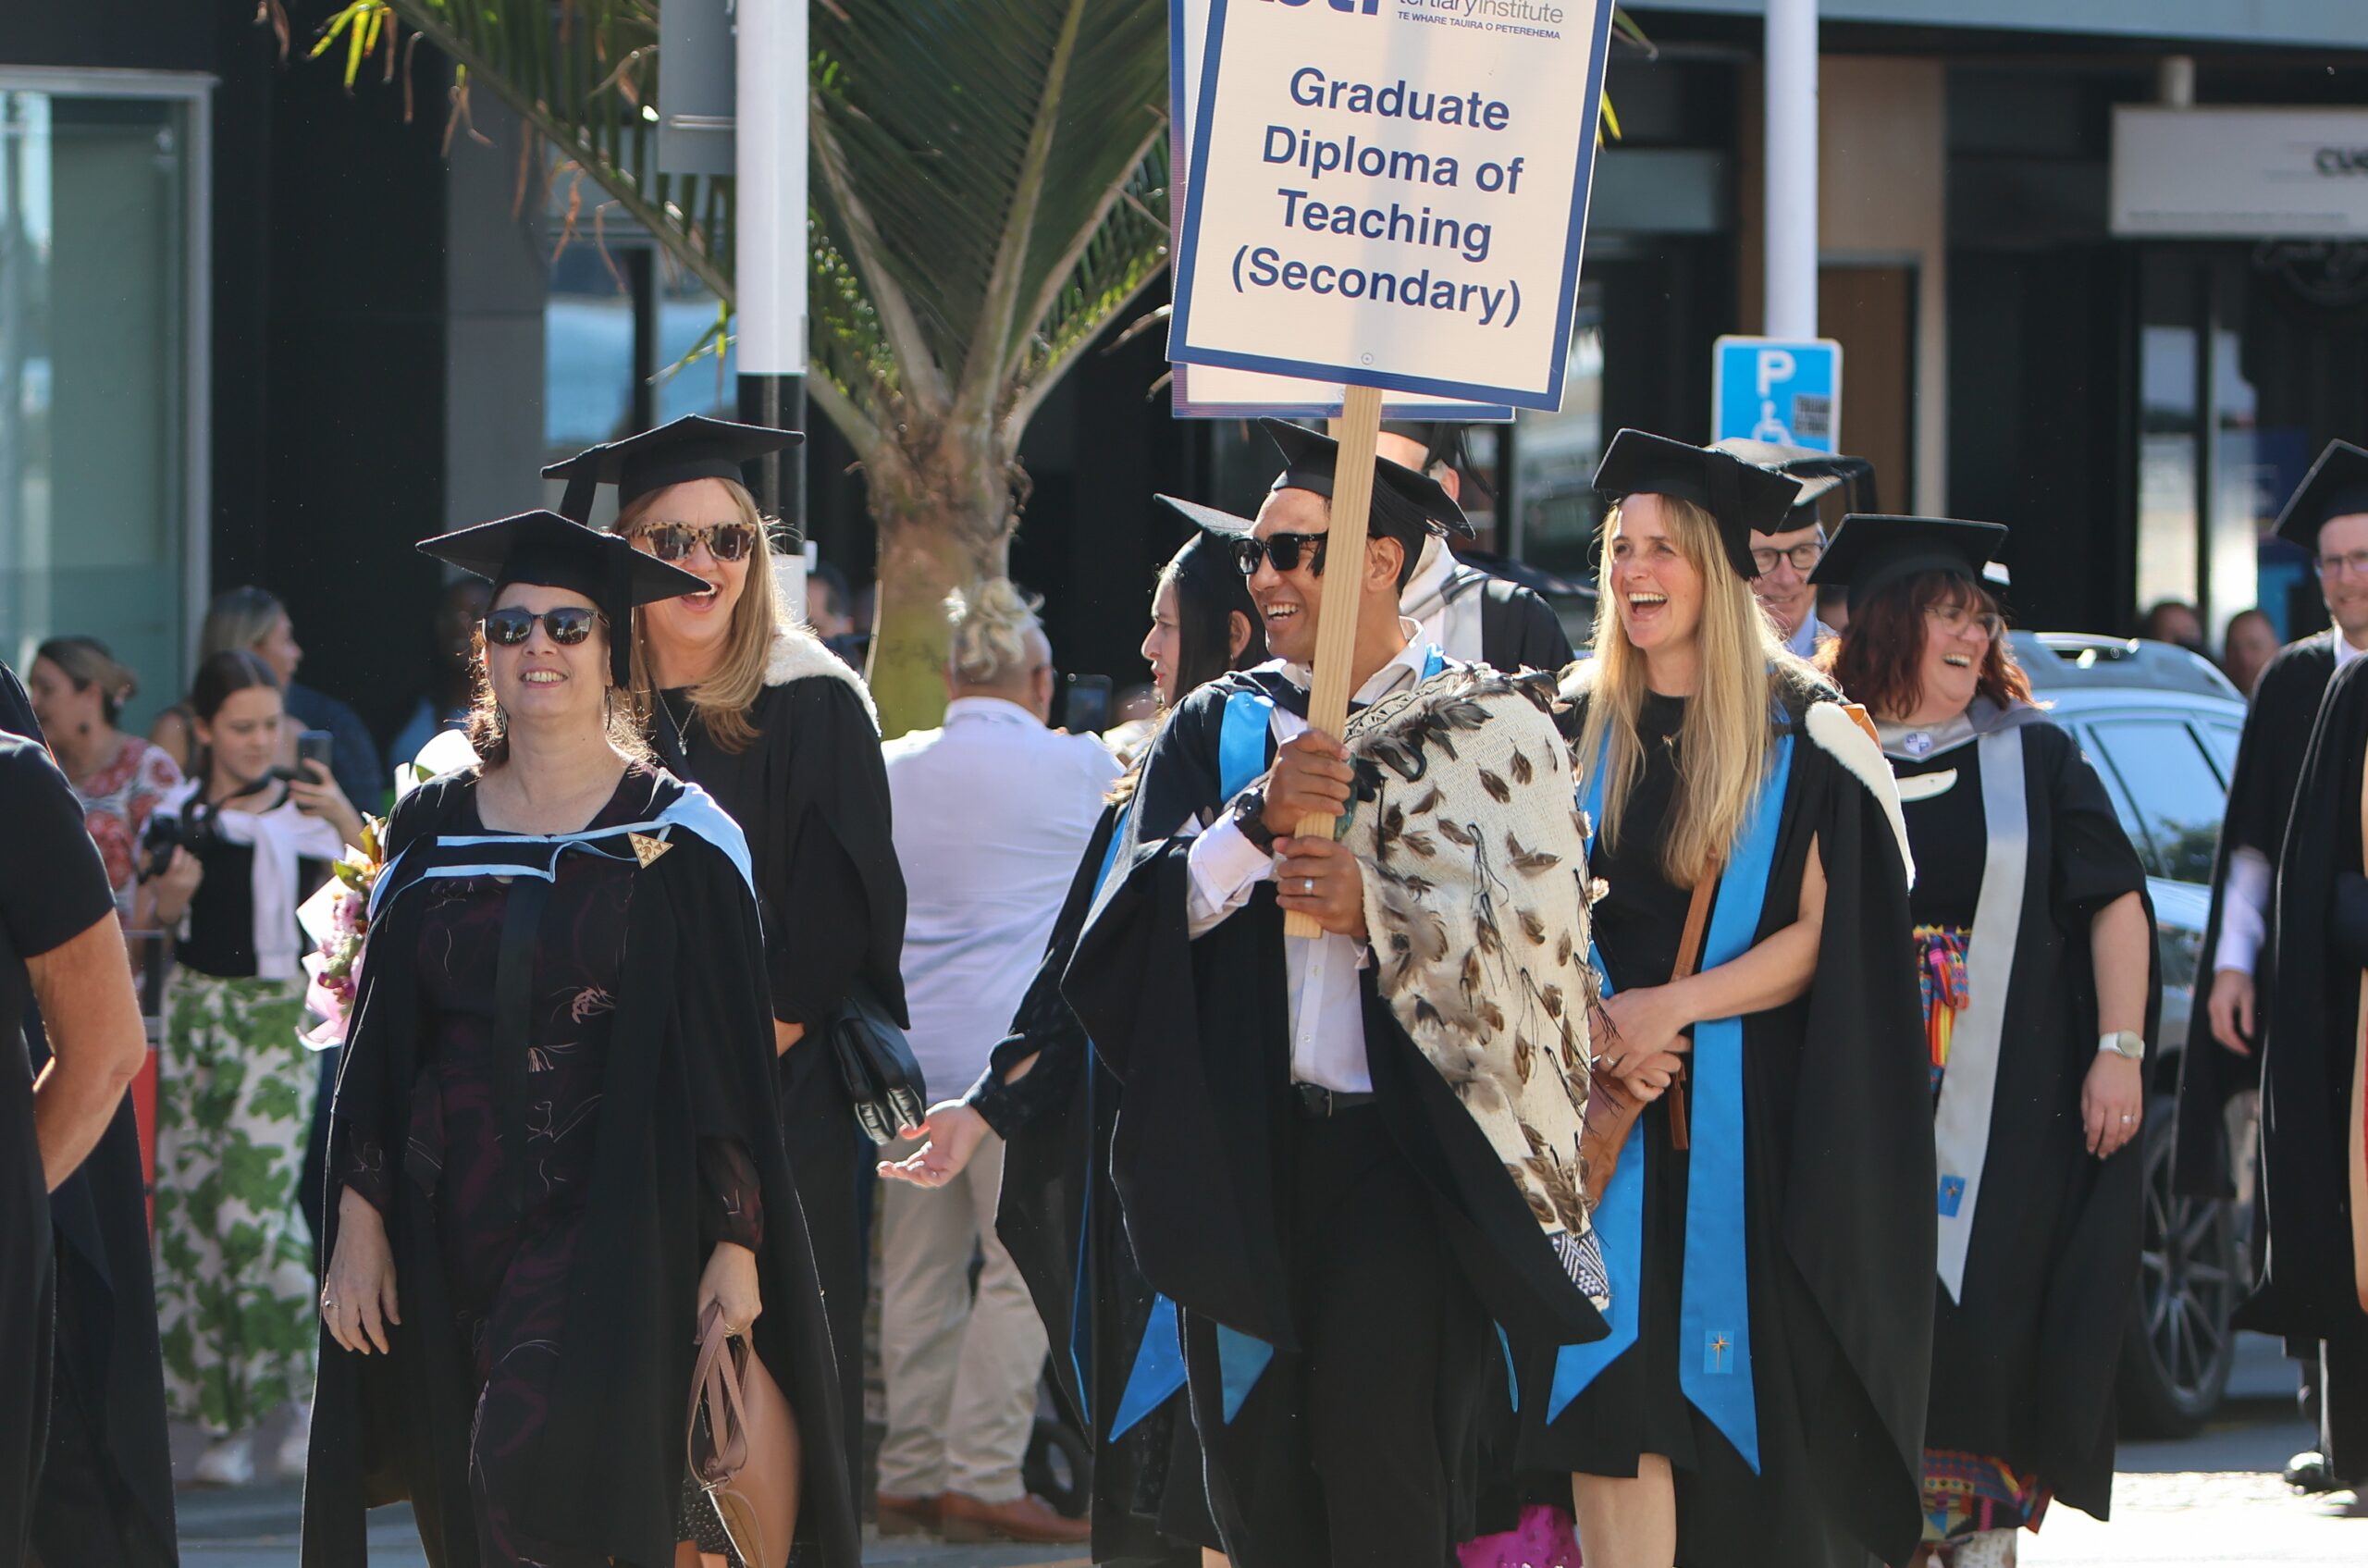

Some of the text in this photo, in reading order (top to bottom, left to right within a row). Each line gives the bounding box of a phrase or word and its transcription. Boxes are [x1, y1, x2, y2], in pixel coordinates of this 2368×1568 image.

[1398, 11, 1561, 40] TE WHARE TAUIRA O PETEREHEMA
[1289, 67, 1510, 131] Graduate
[1263, 125, 1524, 194] Diploma of
[1277, 188, 1492, 263] Teaching
[1231, 244, 1522, 327] (Secondary)
[1758, 349, 1796, 398] P
